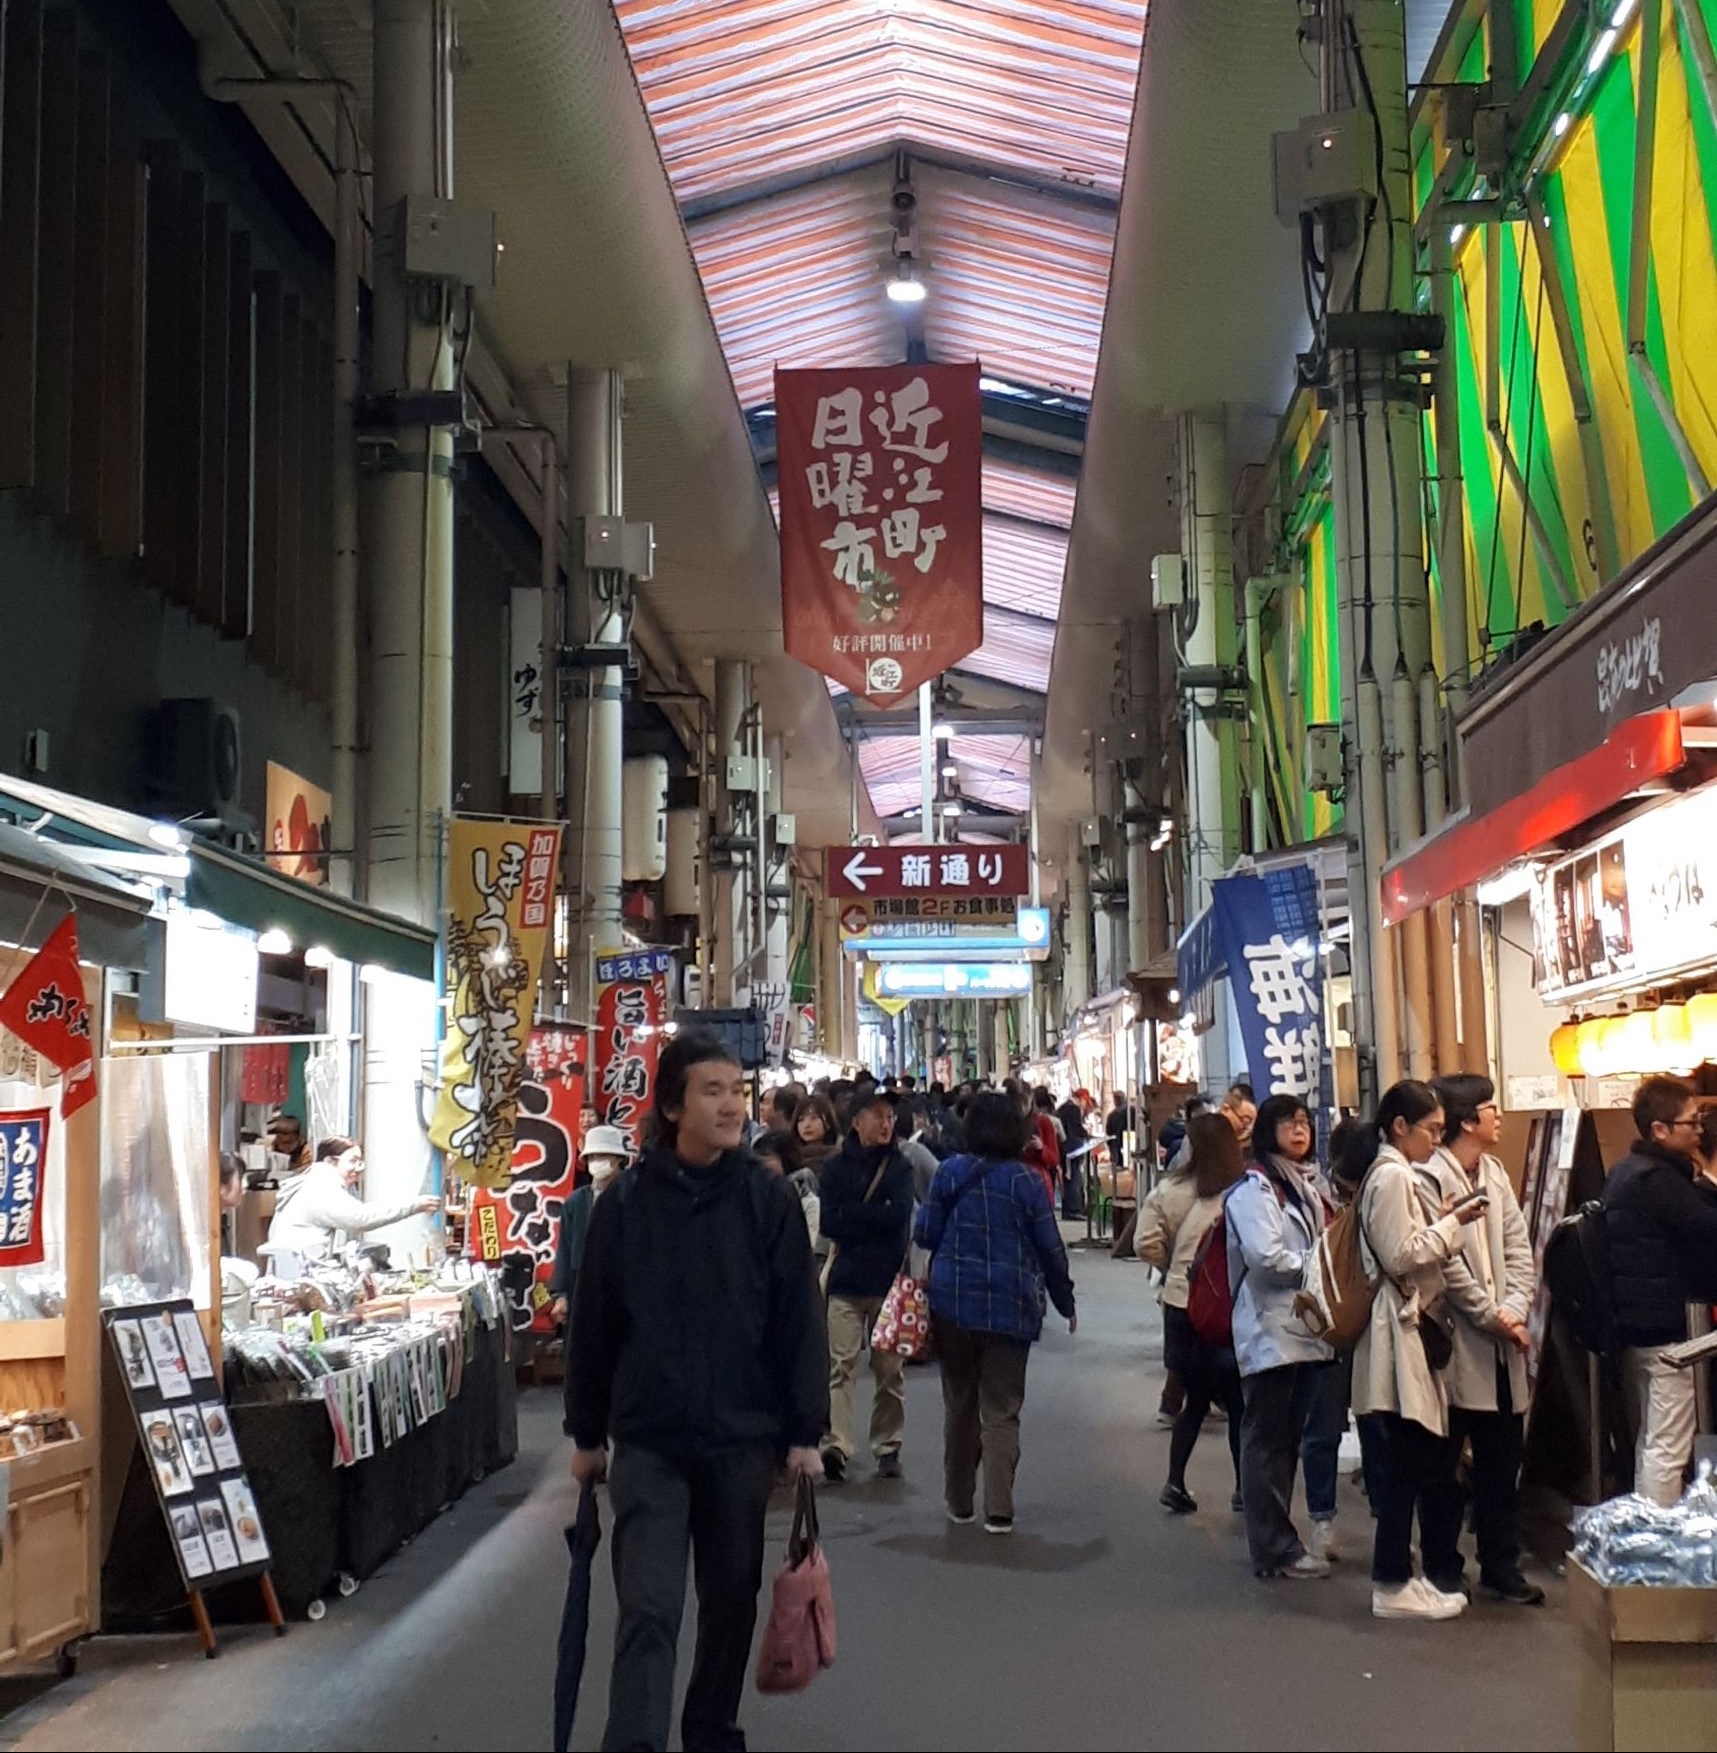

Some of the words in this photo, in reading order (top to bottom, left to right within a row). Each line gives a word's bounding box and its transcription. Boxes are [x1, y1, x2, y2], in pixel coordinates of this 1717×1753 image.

[805, 386, 879, 593] 日曜市
[868, 376, 949, 574] 近江町
[832, 633, 931, 652] 好評開催中!
[514, 663, 539, 718] ゆず
[525, 834, 555, 925] 加賀乃国
[901, 853, 1003, 887] 新通り
[559, 1034, 581, 1090] じっくり
[7, 1126, 38, 1242] あま酒
[488, 1079, 574, 1332] うなぎ
[482, 1207, 498, 1258] こだわり
